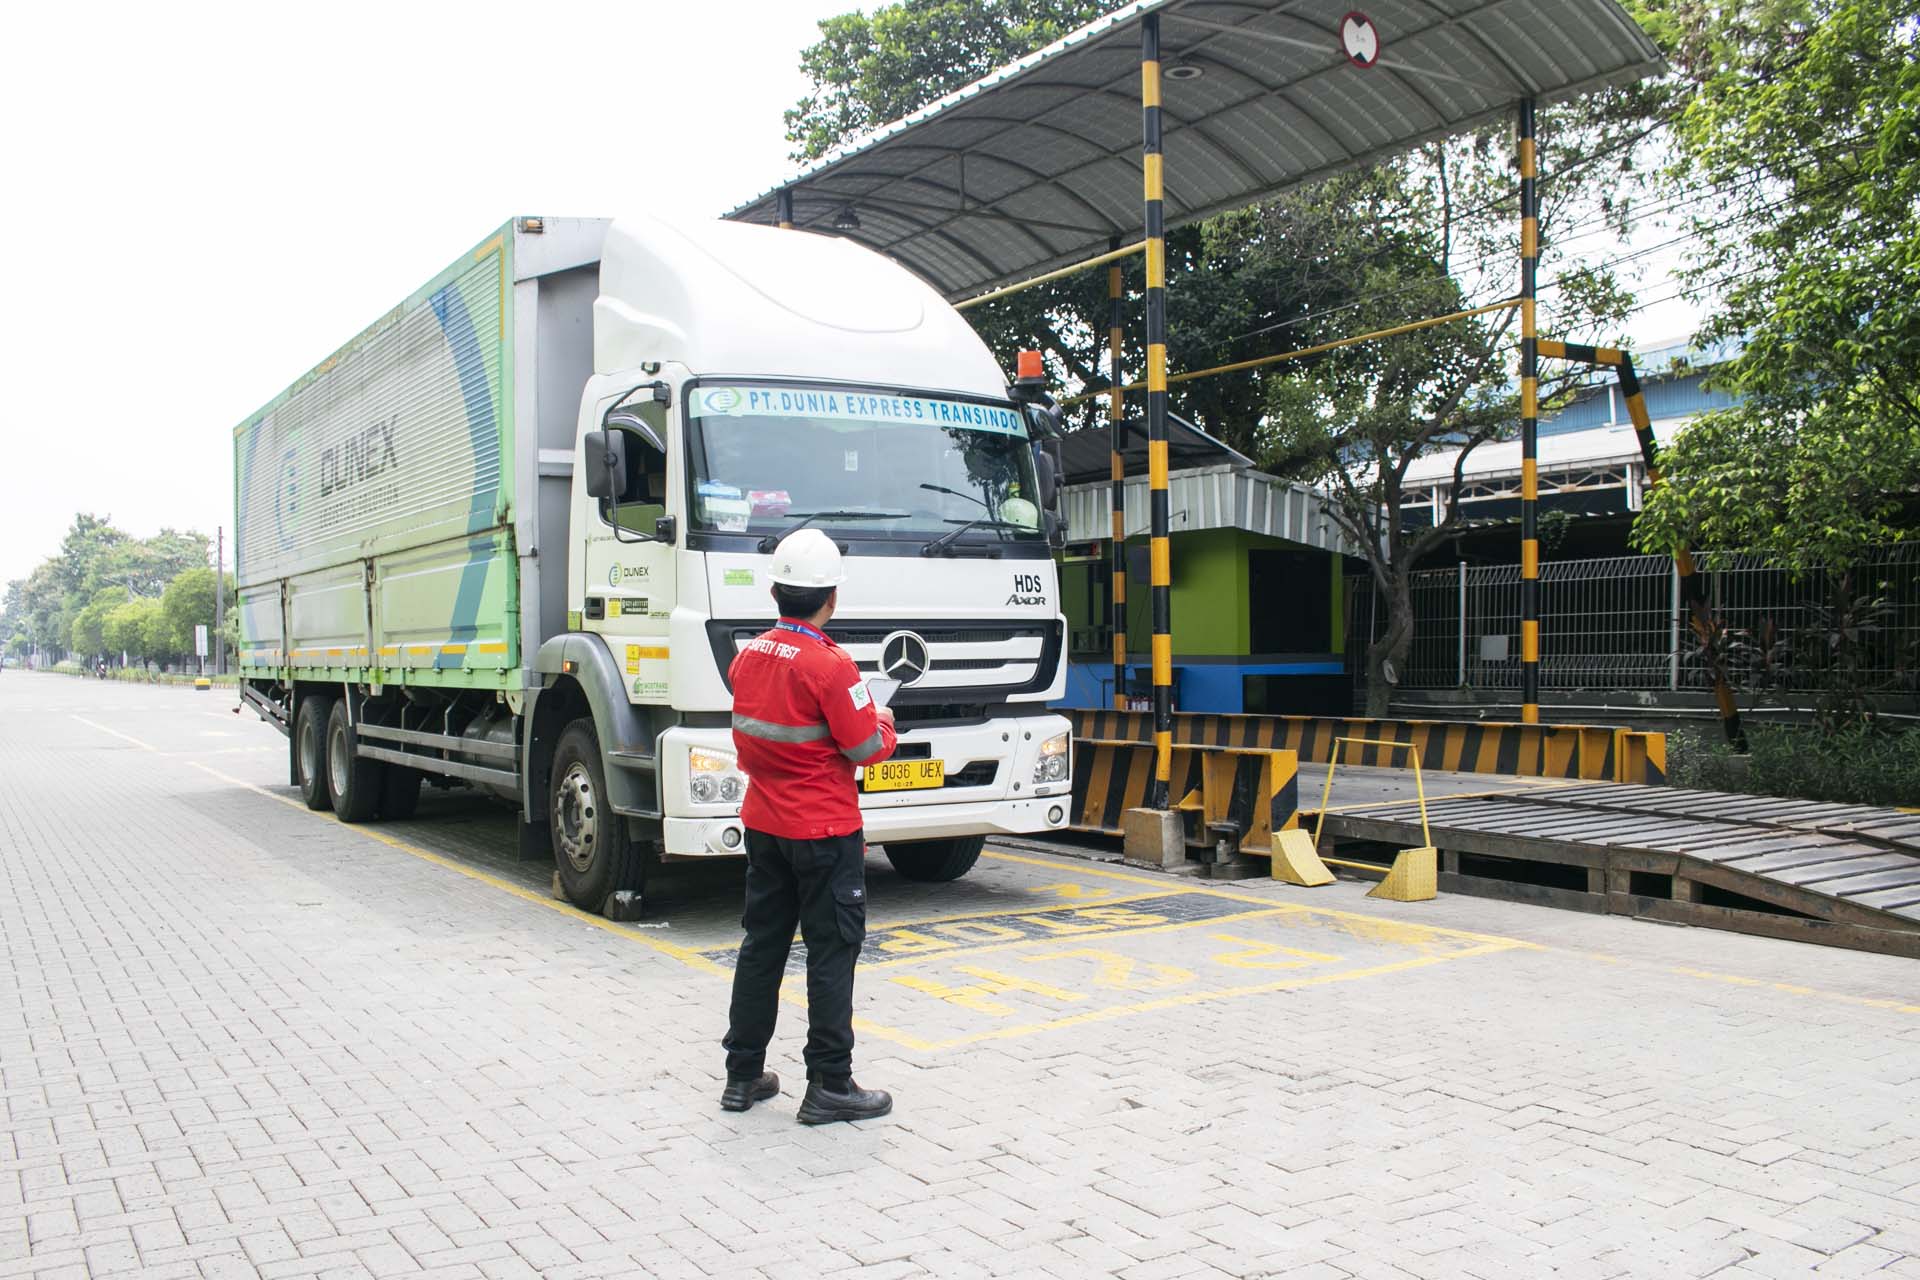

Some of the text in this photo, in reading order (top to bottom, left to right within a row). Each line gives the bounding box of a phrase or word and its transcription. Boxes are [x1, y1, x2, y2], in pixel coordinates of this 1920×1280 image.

[780, 392, 839, 413] DUNIA
[846, 396, 923, 419] EXPRESS
[929, 402, 1019, 430] TRANSINDO
[320, 414, 399, 498] DUNEX
[623, 565, 649, 577] DUNEX
[1013, 574, 1042, 593] HDS
[749, 638, 801, 660] SAFETY FIRST
[868, 762, 942, 781] B 9036 UEX
[878, 907, 1169, 954] STOP
